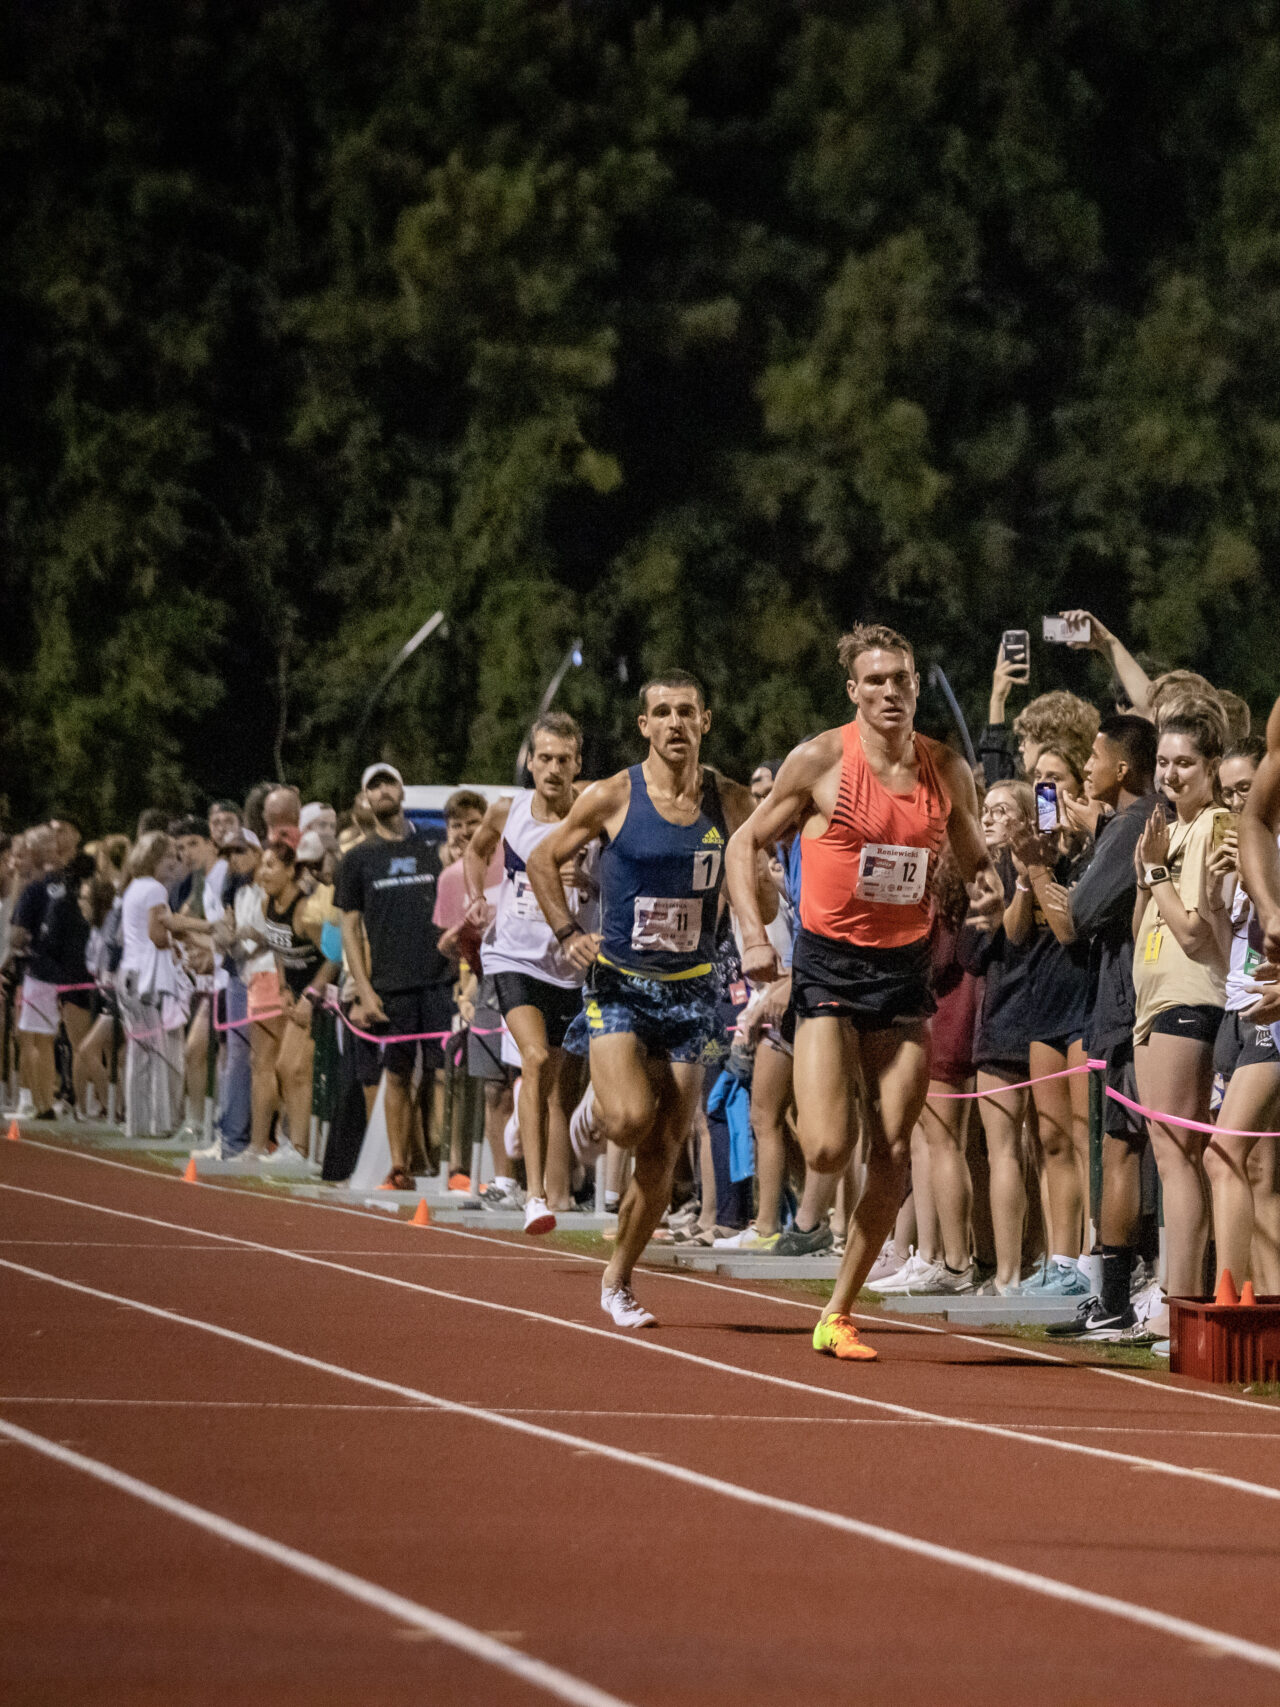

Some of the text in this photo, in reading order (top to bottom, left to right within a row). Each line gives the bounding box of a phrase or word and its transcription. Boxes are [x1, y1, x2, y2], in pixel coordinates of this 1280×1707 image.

[702, 853, 713, 887] 1
[903, 862, 917, 882] 12
[677, 913, 688, 931] 11
